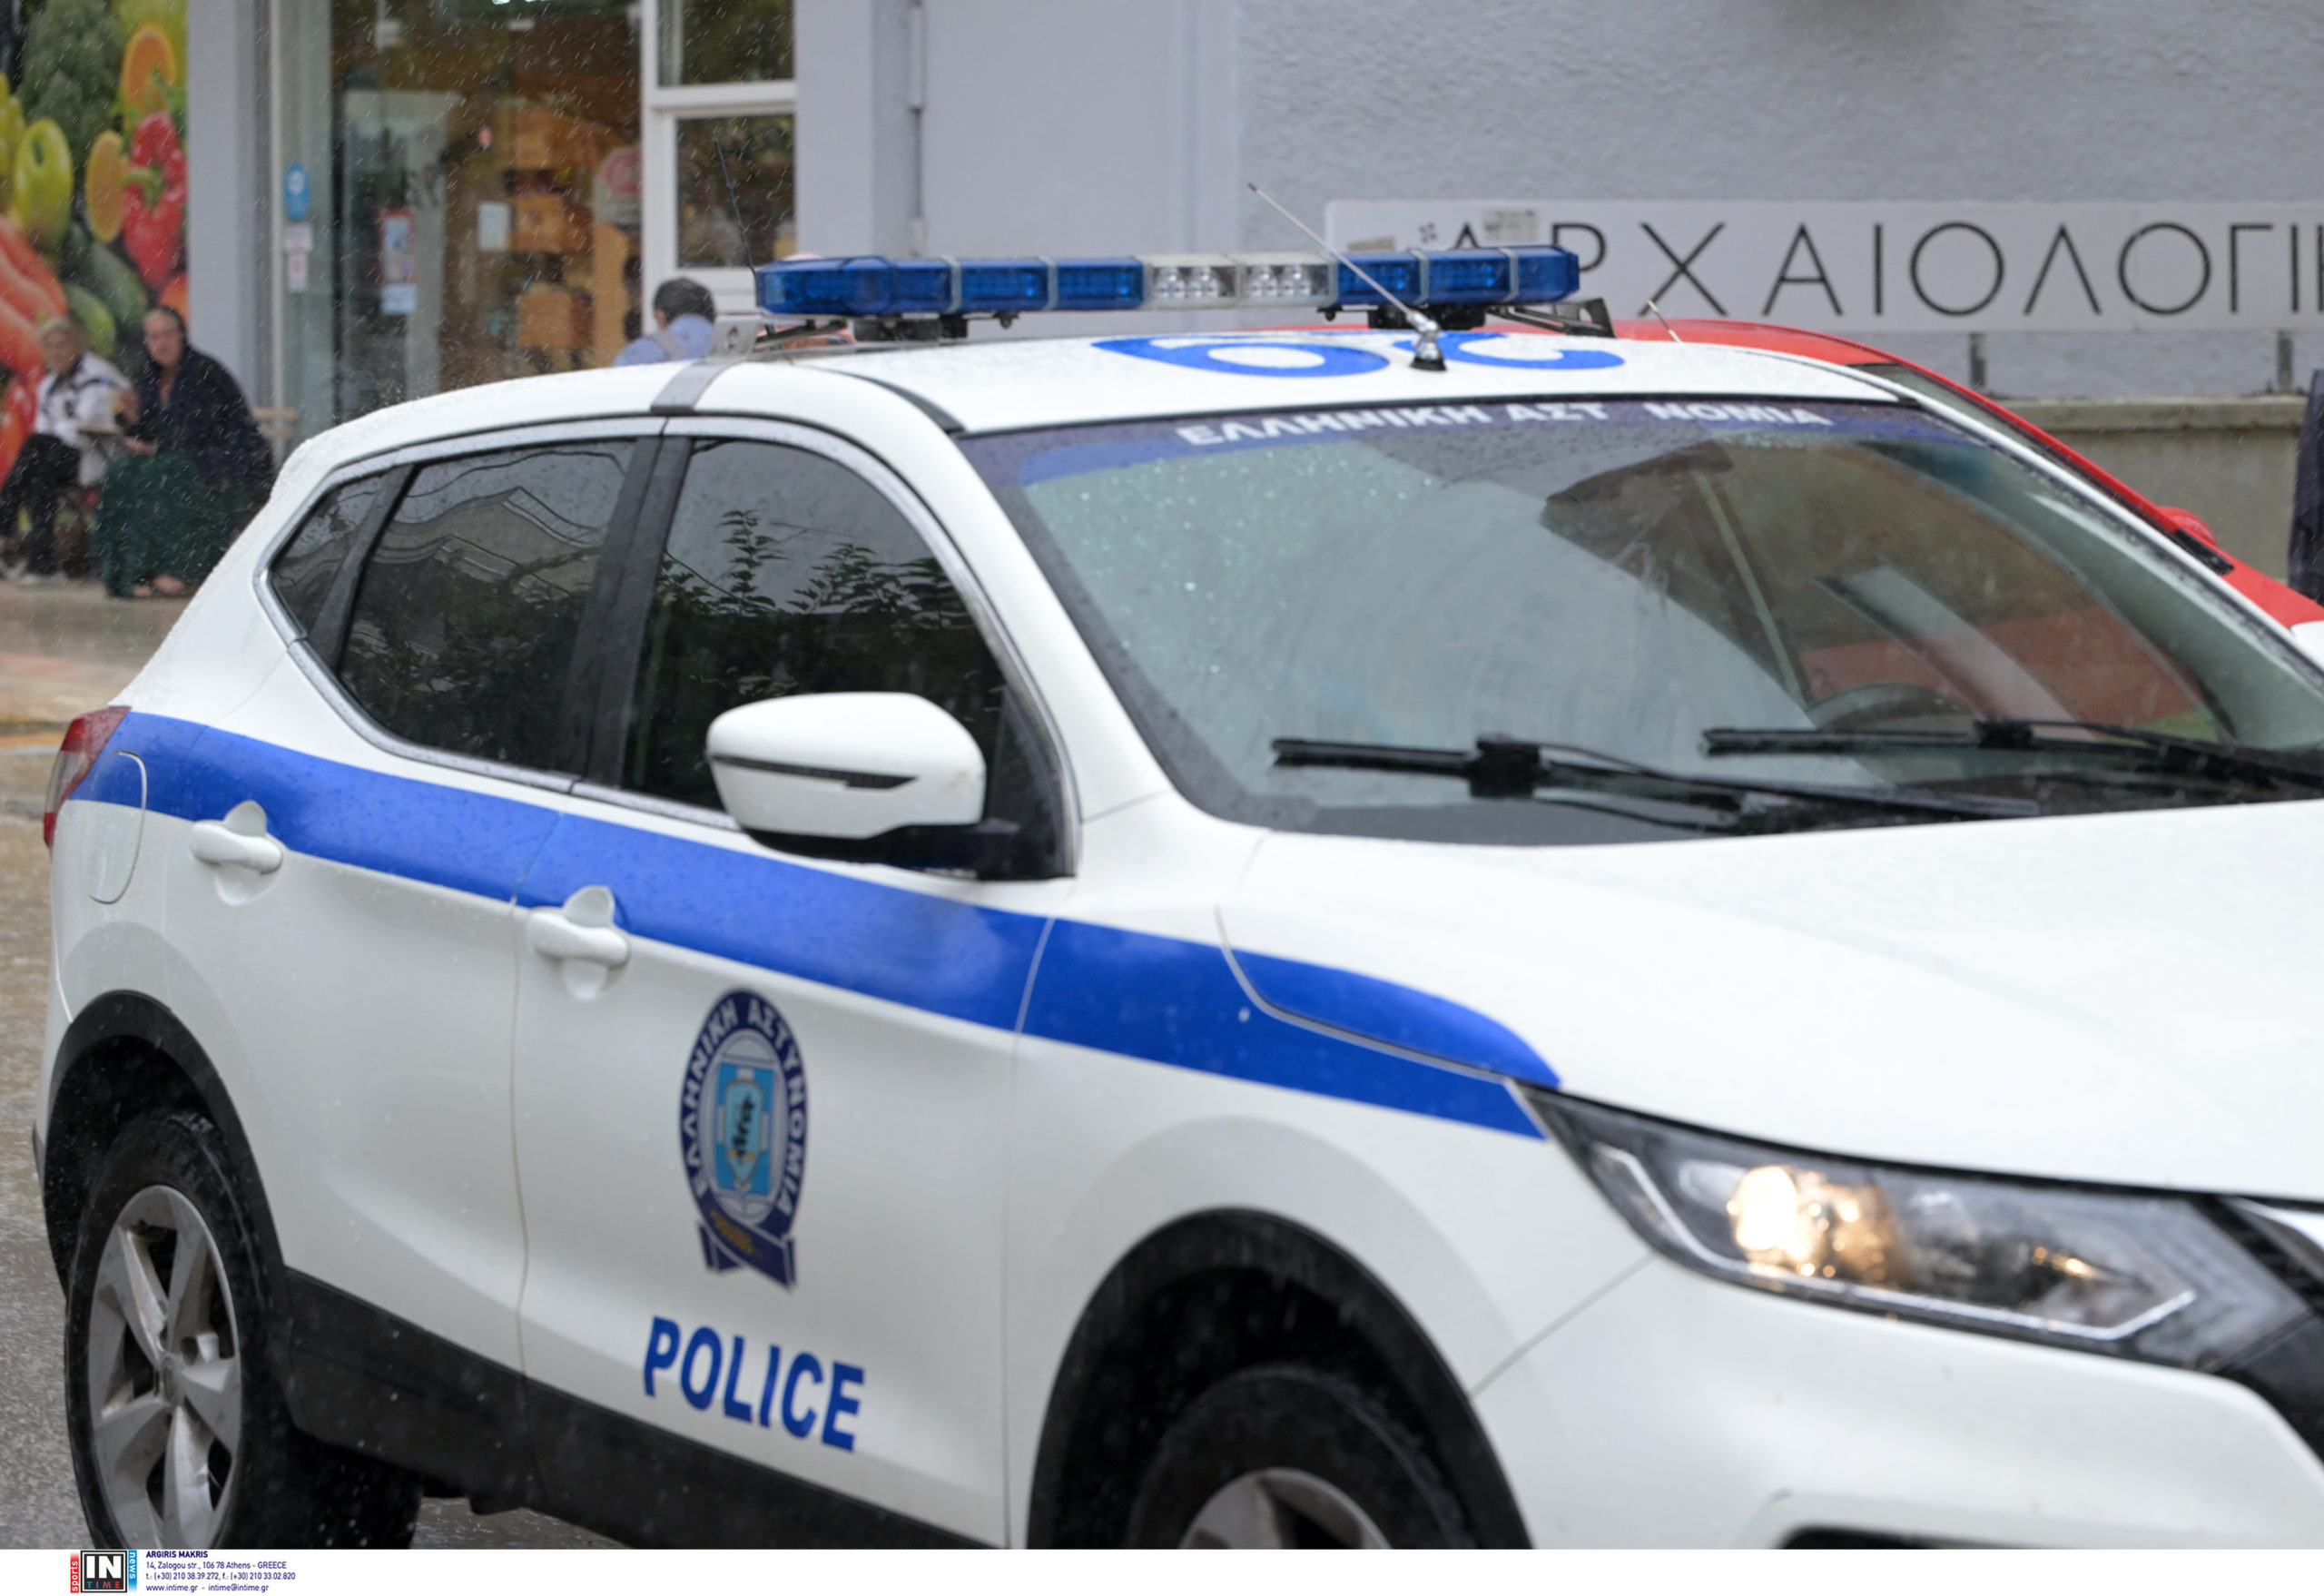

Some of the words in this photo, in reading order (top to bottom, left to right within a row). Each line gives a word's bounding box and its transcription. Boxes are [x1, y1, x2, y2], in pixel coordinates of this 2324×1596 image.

[1177, 405, 1492, 445] ΕΛΛΗΝΙΚΗ
[683, 1000, 738, 1198] ΕΛΛΗΝΙΚΗ
[747, 998, 803, 1217] ΑΣΤΥΝΟΜΙΑ
[643, 1315, 865, 1453] POLICE
